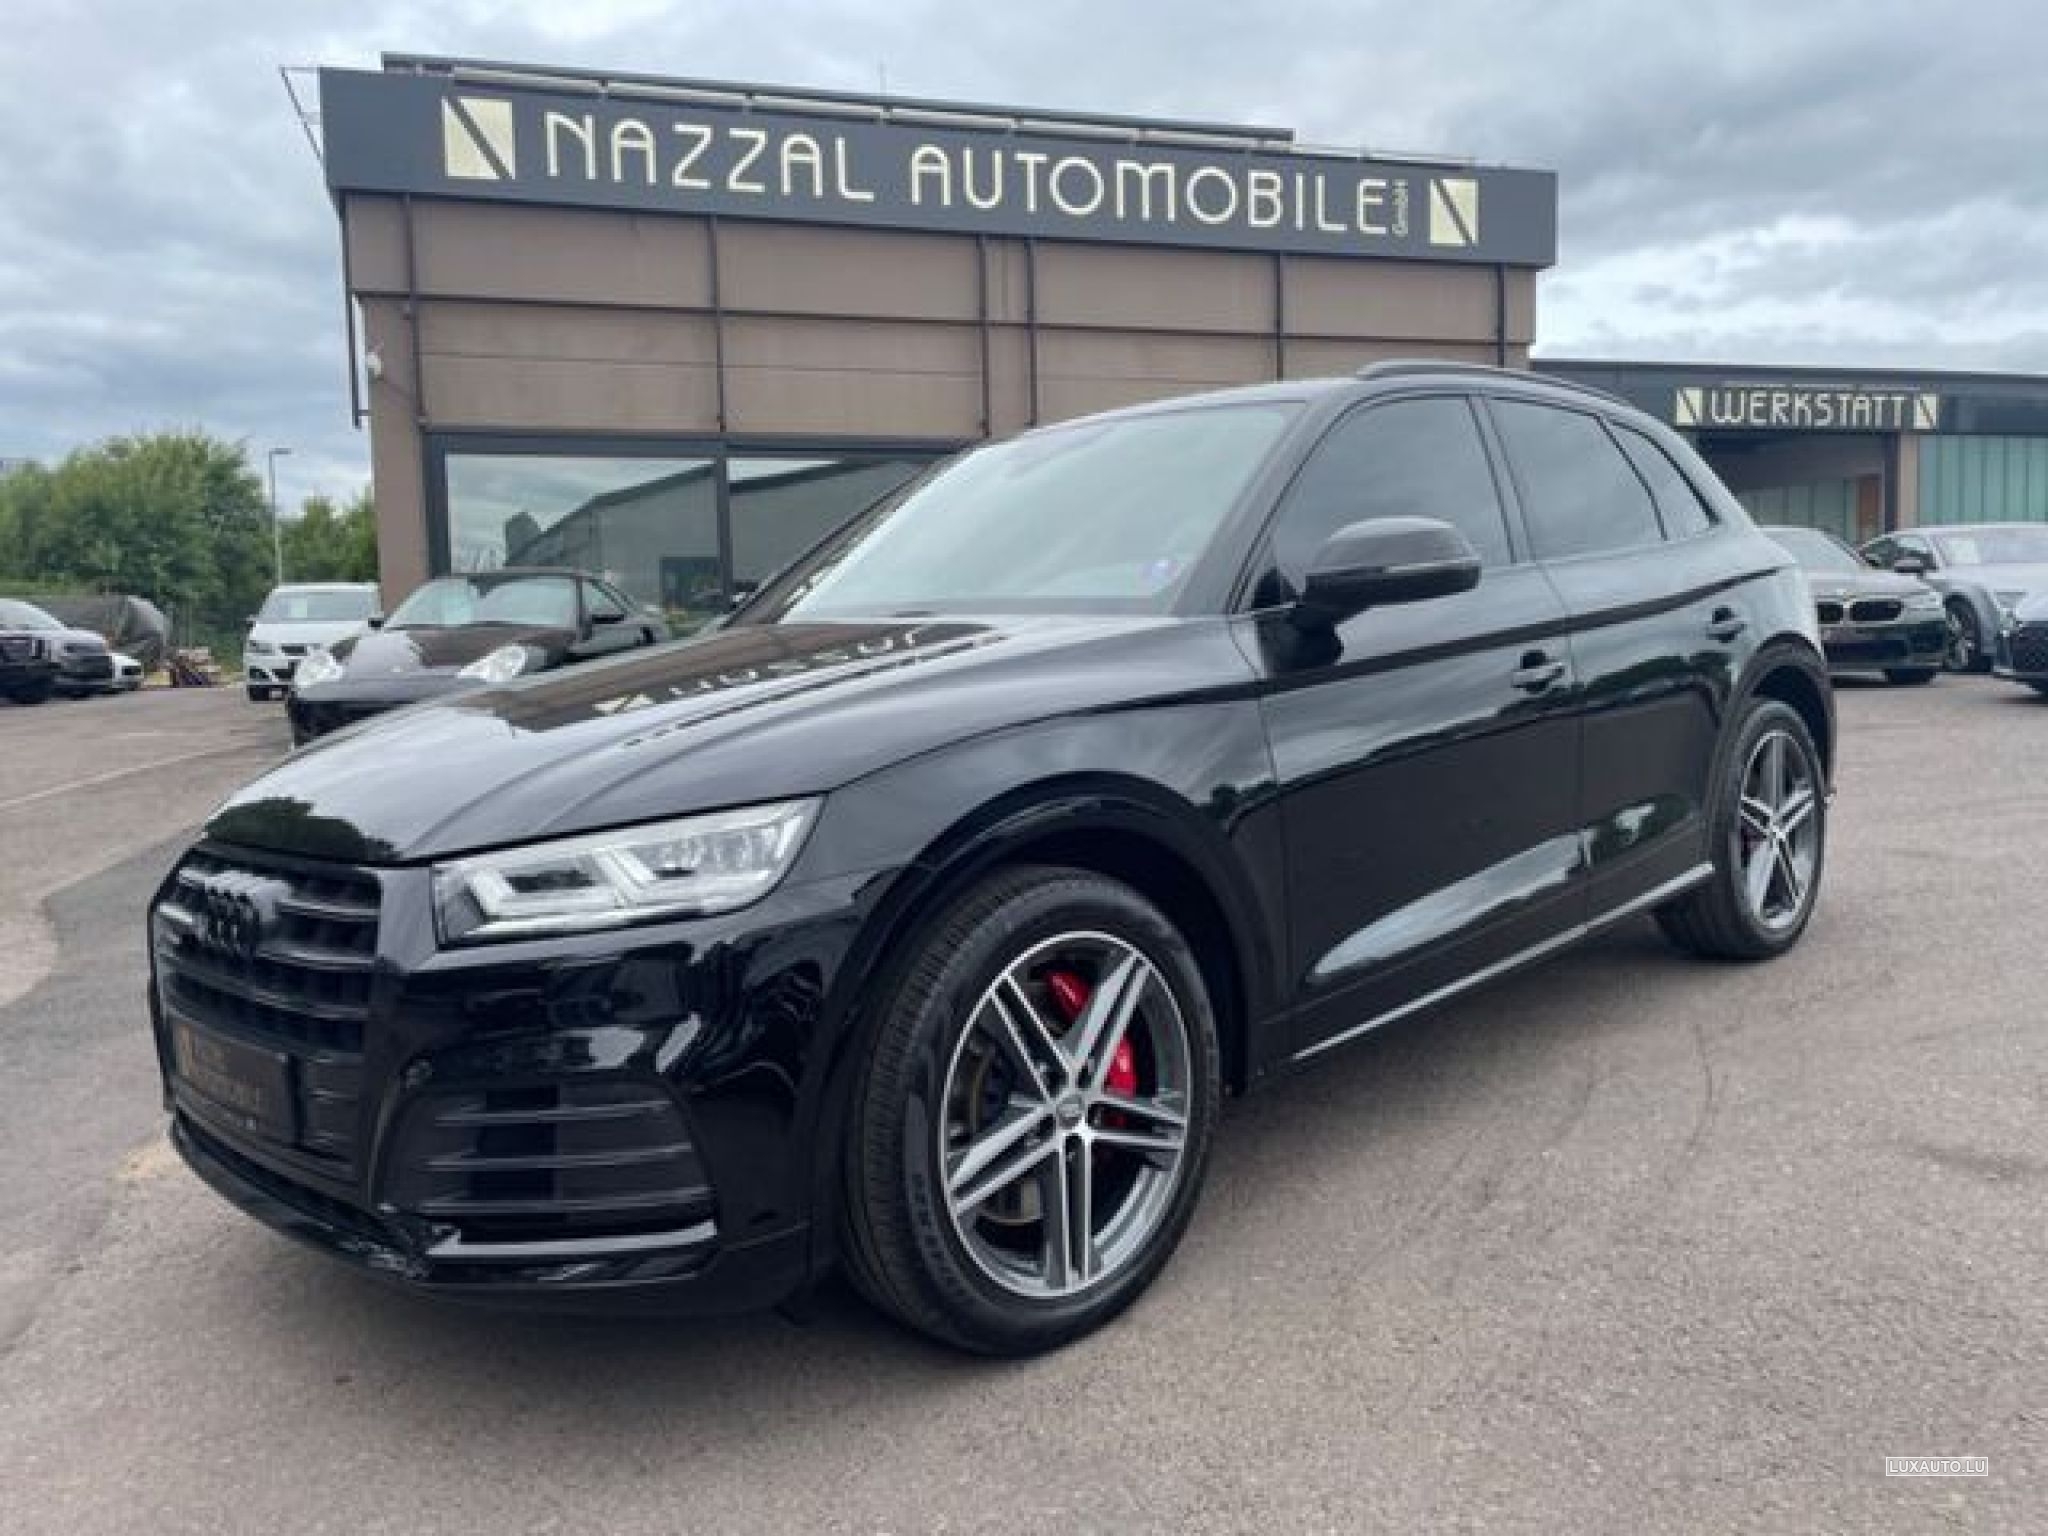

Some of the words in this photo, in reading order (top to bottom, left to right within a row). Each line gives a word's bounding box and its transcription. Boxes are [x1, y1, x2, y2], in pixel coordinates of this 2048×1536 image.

[544, 111, 874, 201] NAZZAL
[911, 144, 1387, 235] AUTOMOBILE
[1711, 390, 1905, 427] WERKSTATT
